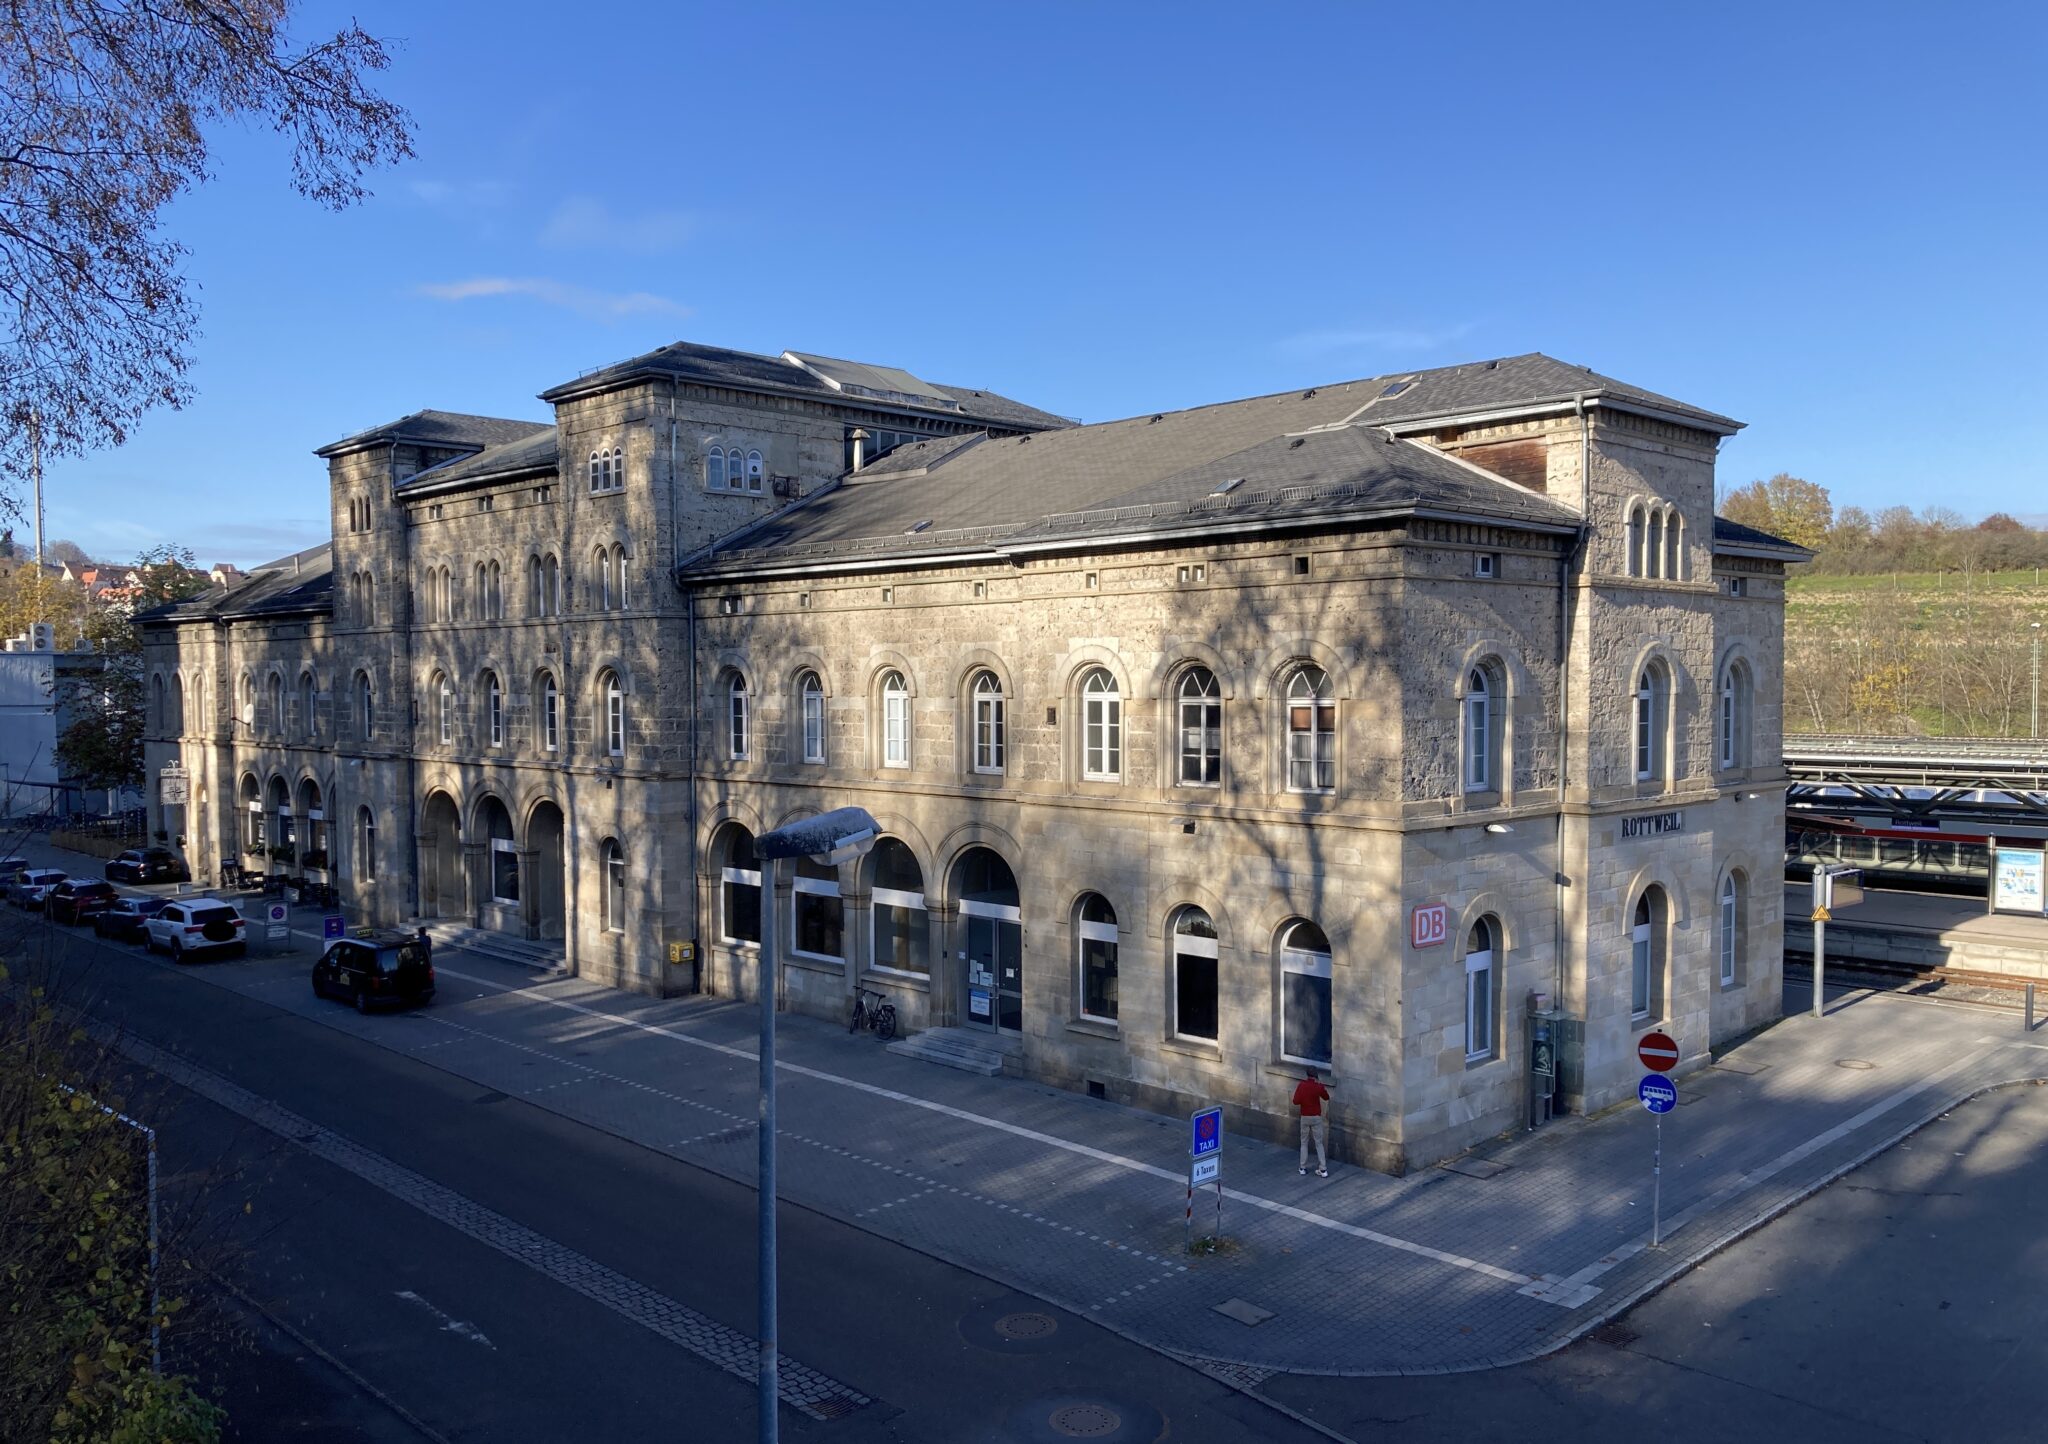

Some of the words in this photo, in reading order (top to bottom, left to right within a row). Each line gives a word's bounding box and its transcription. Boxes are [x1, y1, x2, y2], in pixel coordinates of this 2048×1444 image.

[1621, 812, 1681, 838] ROTTWEIL
[1418, 910, 1444, 941] DB
[1199, 1139, 1214, 1151] TAXI
[1201, 1164, 1215, 1175] Taxen
